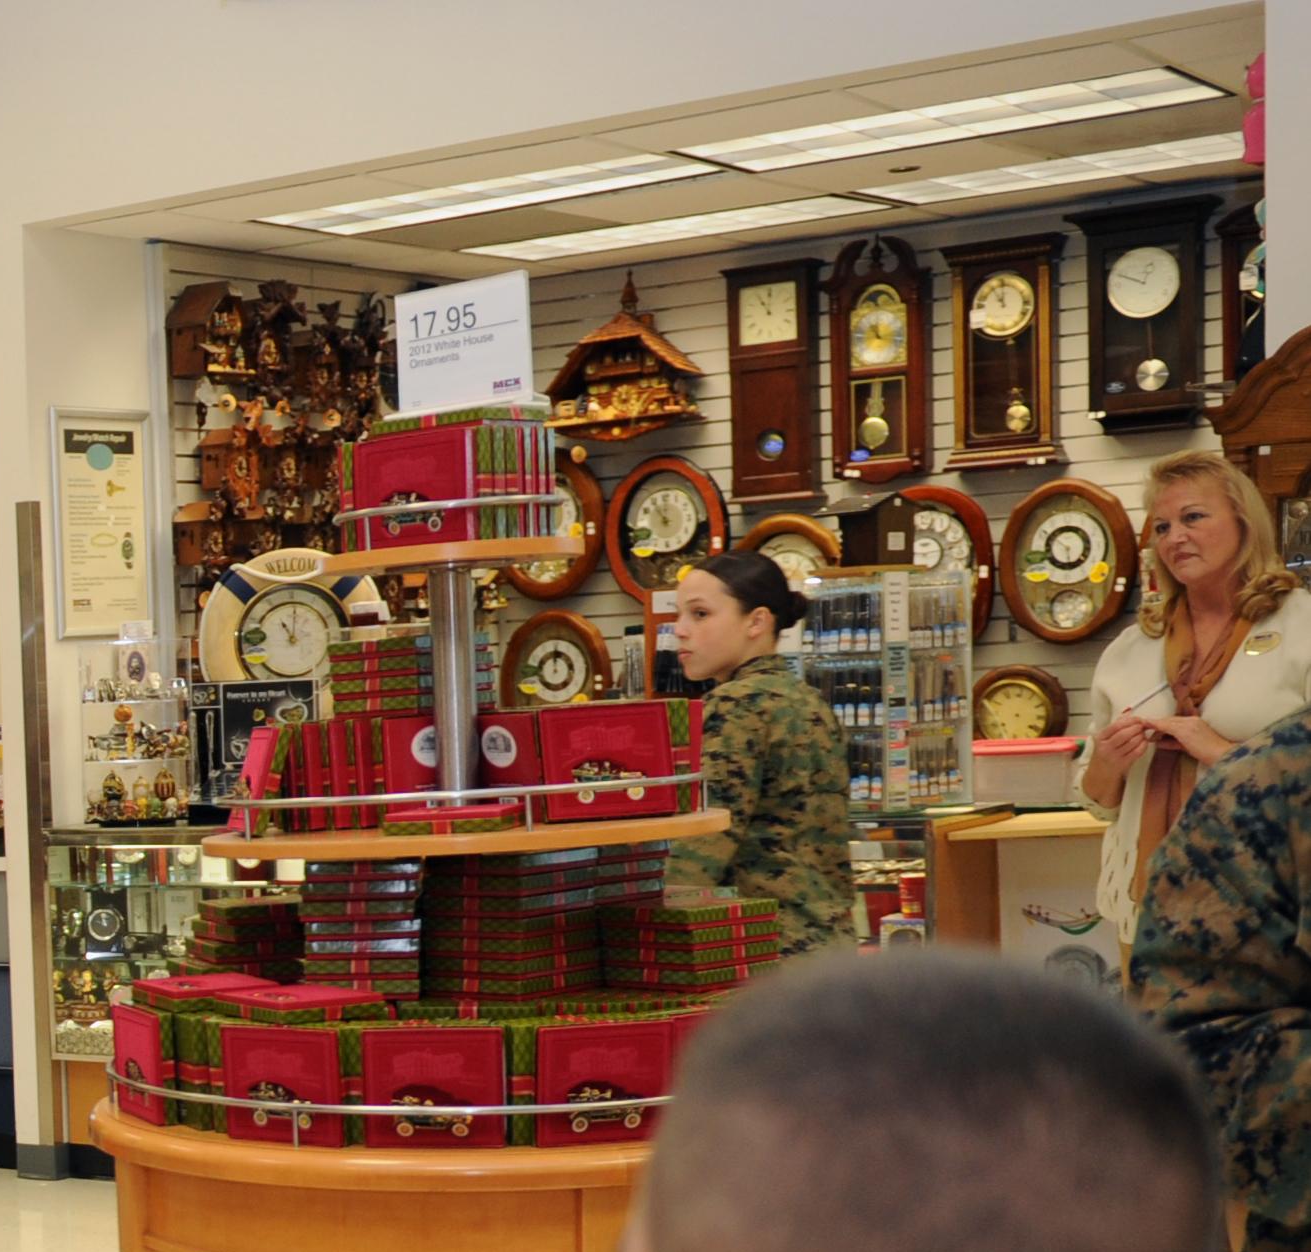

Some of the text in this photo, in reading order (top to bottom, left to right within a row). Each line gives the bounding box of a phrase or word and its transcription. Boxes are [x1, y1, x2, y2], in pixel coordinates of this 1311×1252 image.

[409, 302, 477, 338] 17.95
[409, 333, 494, 357] 2012 White House
[409, 352, 460, 369] Ornaments
[492, 377, 521, 389] MCX
[265, 557, 318, 574] WELCOM
